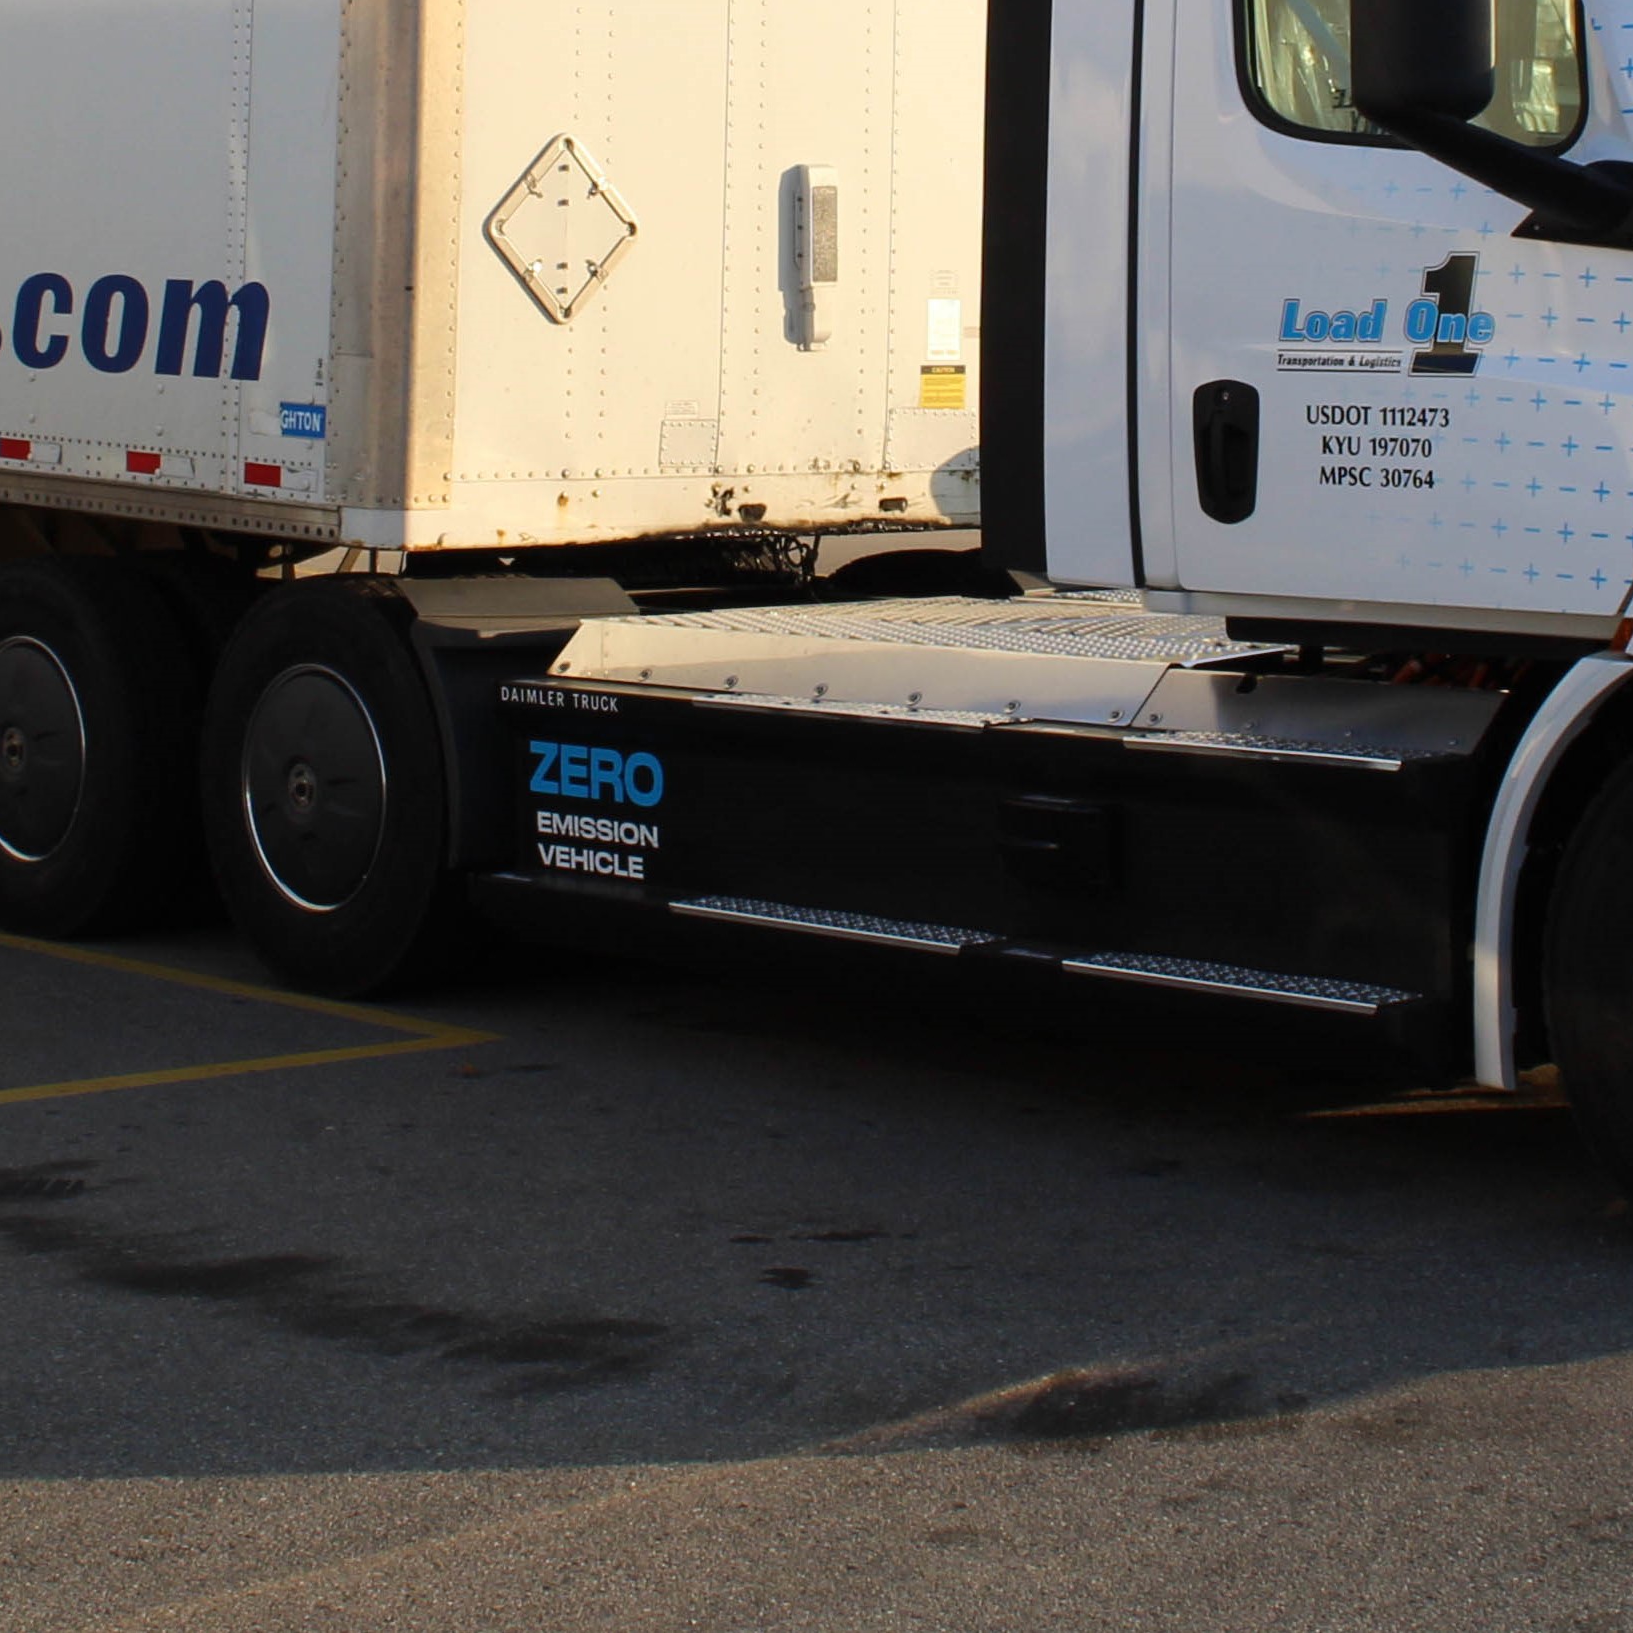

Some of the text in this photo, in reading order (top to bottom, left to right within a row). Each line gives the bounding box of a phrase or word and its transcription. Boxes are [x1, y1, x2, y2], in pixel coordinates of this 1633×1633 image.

[1279, 299, 1495, 343] Load One
[1278, 354, 1401, 368] Transportation & Logistics
[1306, 405, 1450, 428] USDOT 1112473
[1322, 435, 1432, 458] KYU 197070
[1319, 466, 1435, 489] MPSC 30764
[501, 685, 618, 712] DAIMLER TRUCK
[529, 740, 664, 807] ZERO
[536, 811, 659, 849] EMISSION
[538, 842, 645, 880] VEHICLE
